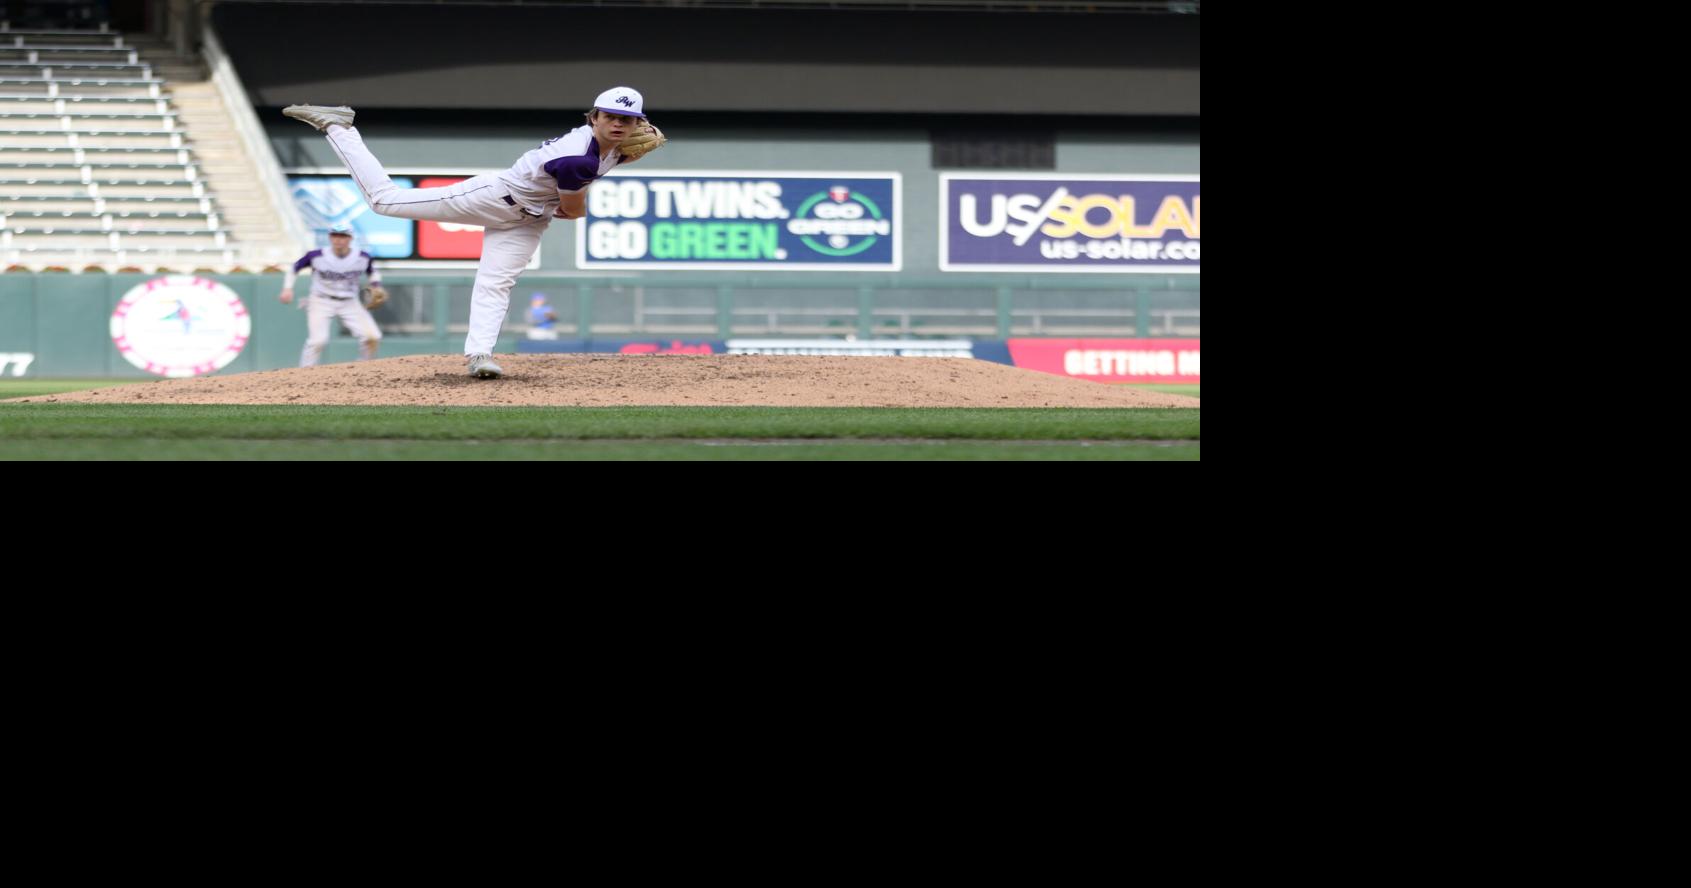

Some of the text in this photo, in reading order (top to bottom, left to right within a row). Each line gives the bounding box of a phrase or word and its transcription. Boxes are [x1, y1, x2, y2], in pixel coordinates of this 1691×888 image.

[588, 180, 789, 219] GO TWINS.
[588, 221, 787, 260] GO GREEN.
[1064, 349, 1175, 376] GETTING
